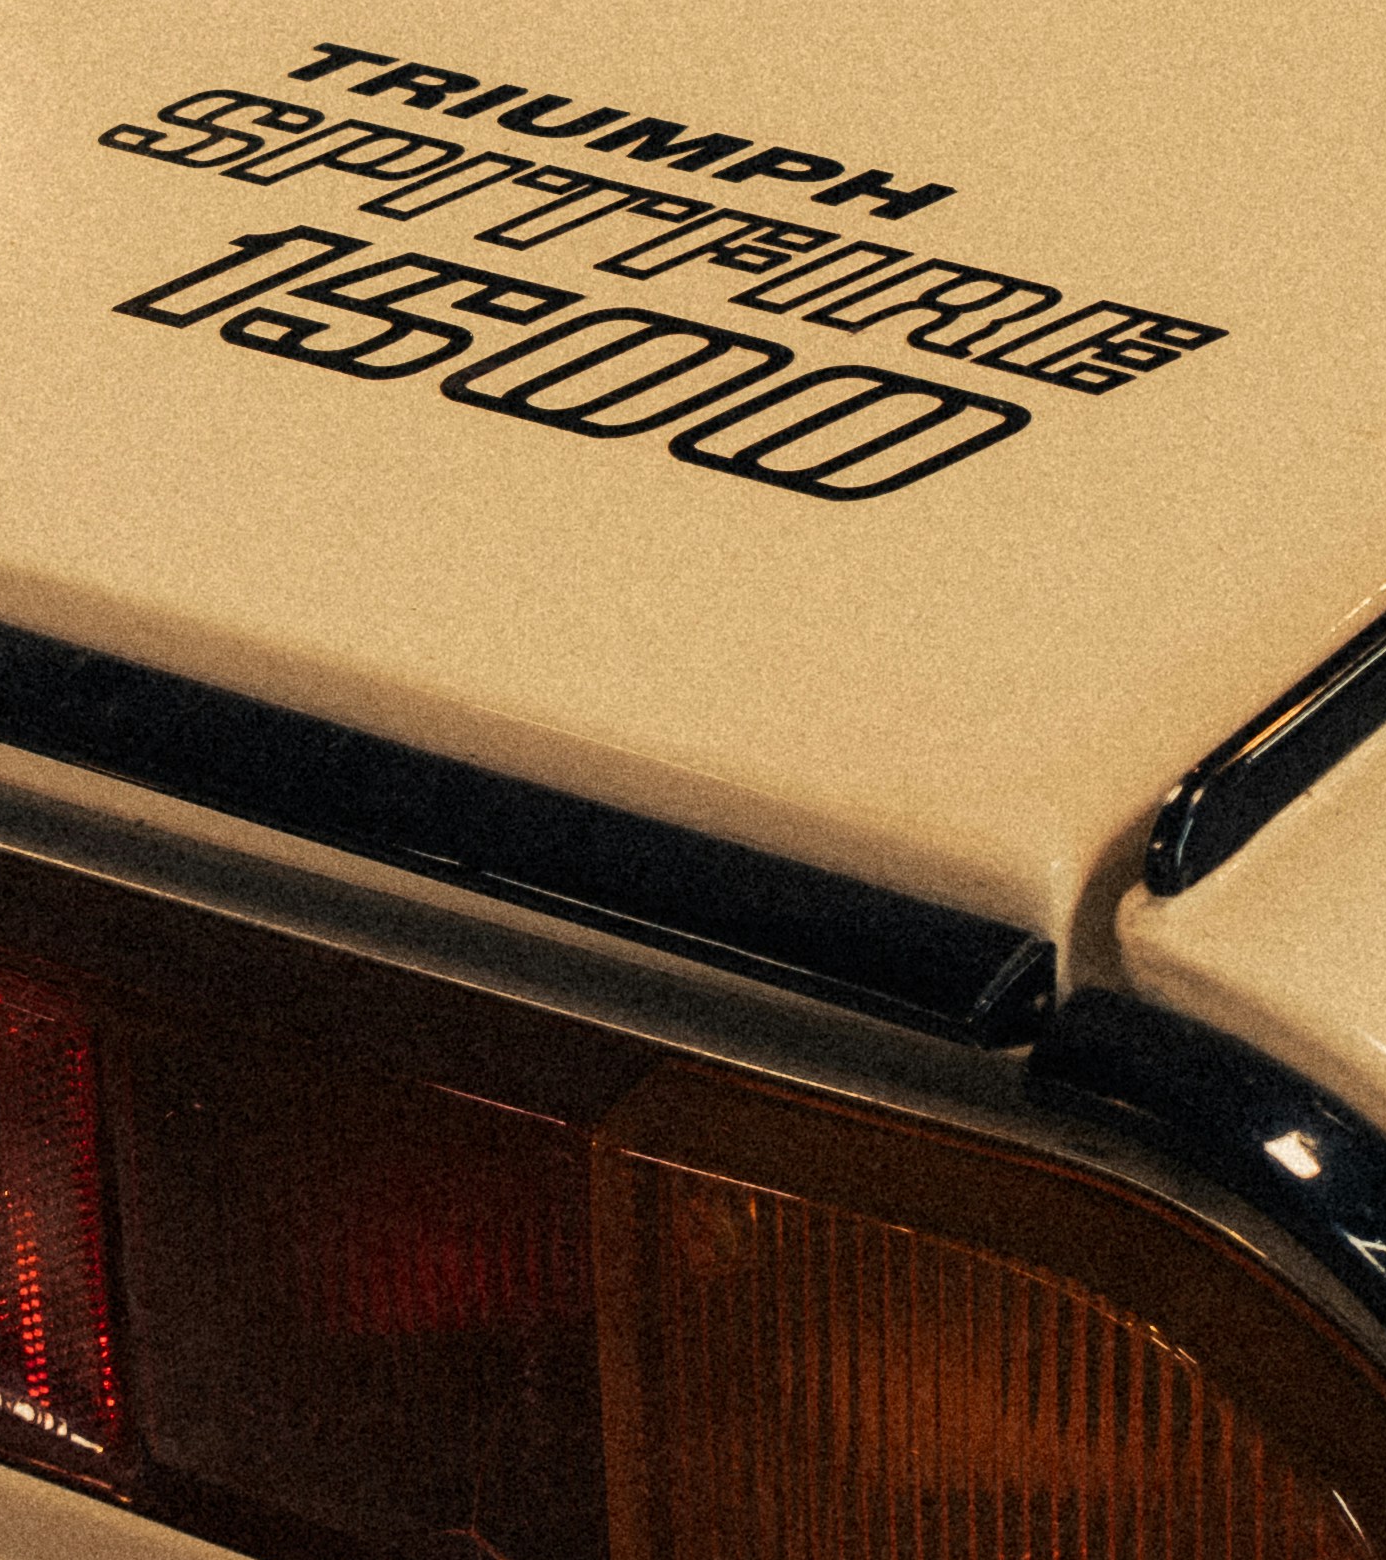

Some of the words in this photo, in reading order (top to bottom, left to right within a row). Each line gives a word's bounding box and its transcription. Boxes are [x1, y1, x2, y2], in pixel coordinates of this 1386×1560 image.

[97, 89, 1229, 396] SPITFIRE
[287, 42, 958, 221] TRIUMPH
[112, 225, 1032, 502] 1500
